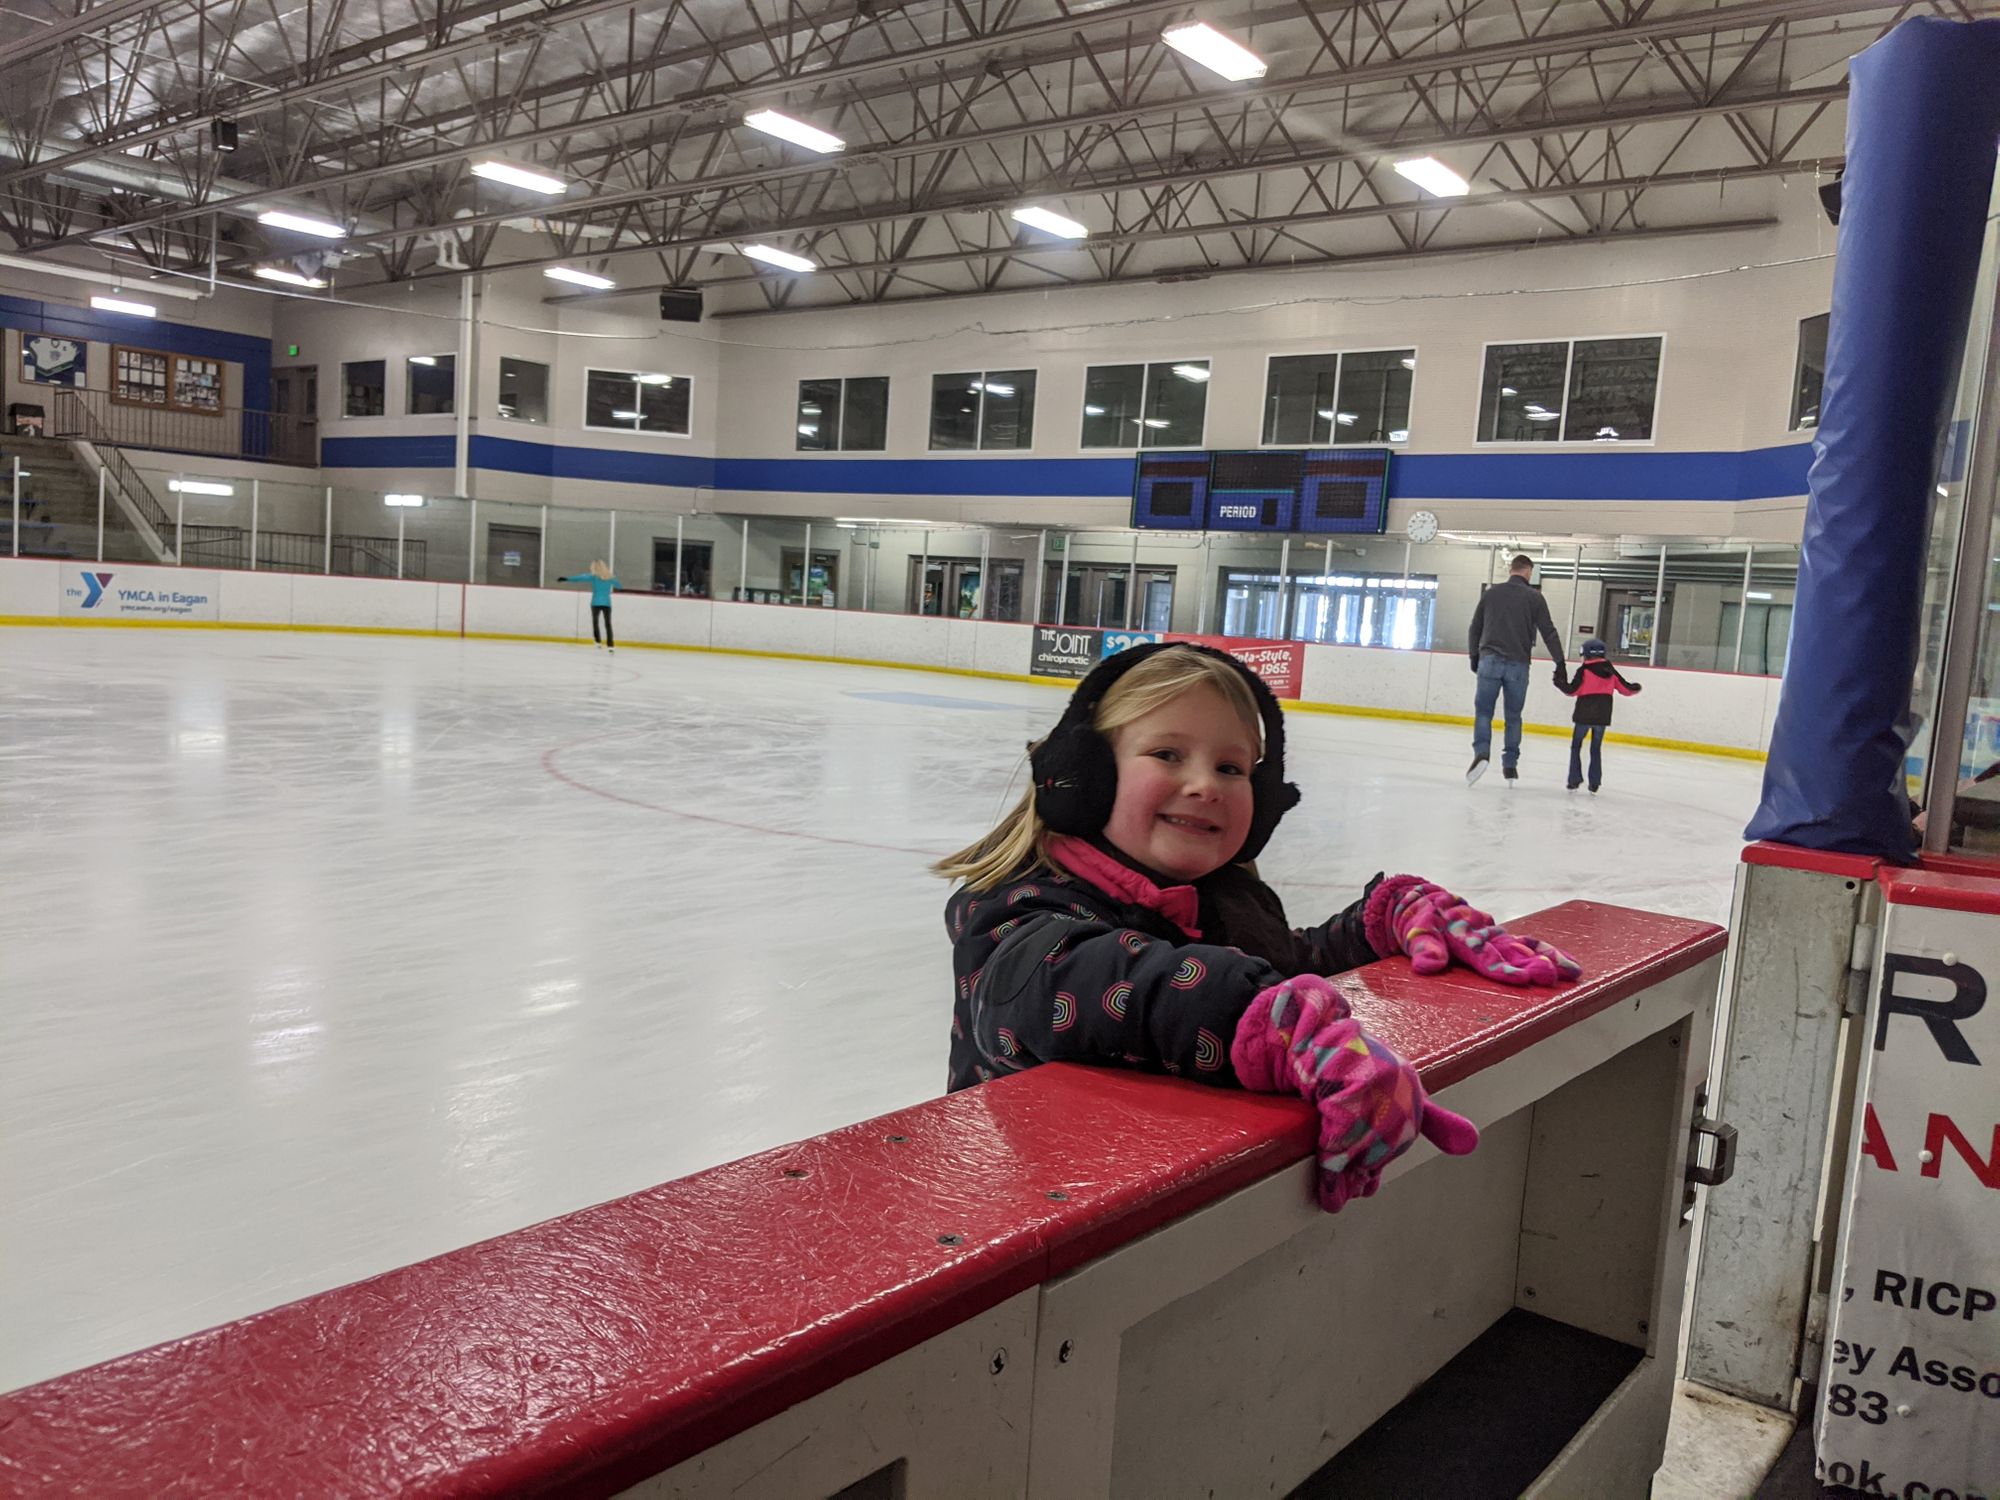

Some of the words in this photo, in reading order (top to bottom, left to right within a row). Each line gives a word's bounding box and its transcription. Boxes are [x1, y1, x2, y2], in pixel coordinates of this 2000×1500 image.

[1220, 506, 1257, 519] PERIOD
[66, 588, 82, 597] the
[118, 589, 156, 603] YMCA
[159, 592, 169, 603] in
[172, 592, 208, 606] Eagan
[1052, 633, 1092, 655] JOINT
[1038, 653, 1090, 666] chiropractic
[1259, 662, 1290, 675] 1965.
[1828, 1383, 1889, 1425] 83
